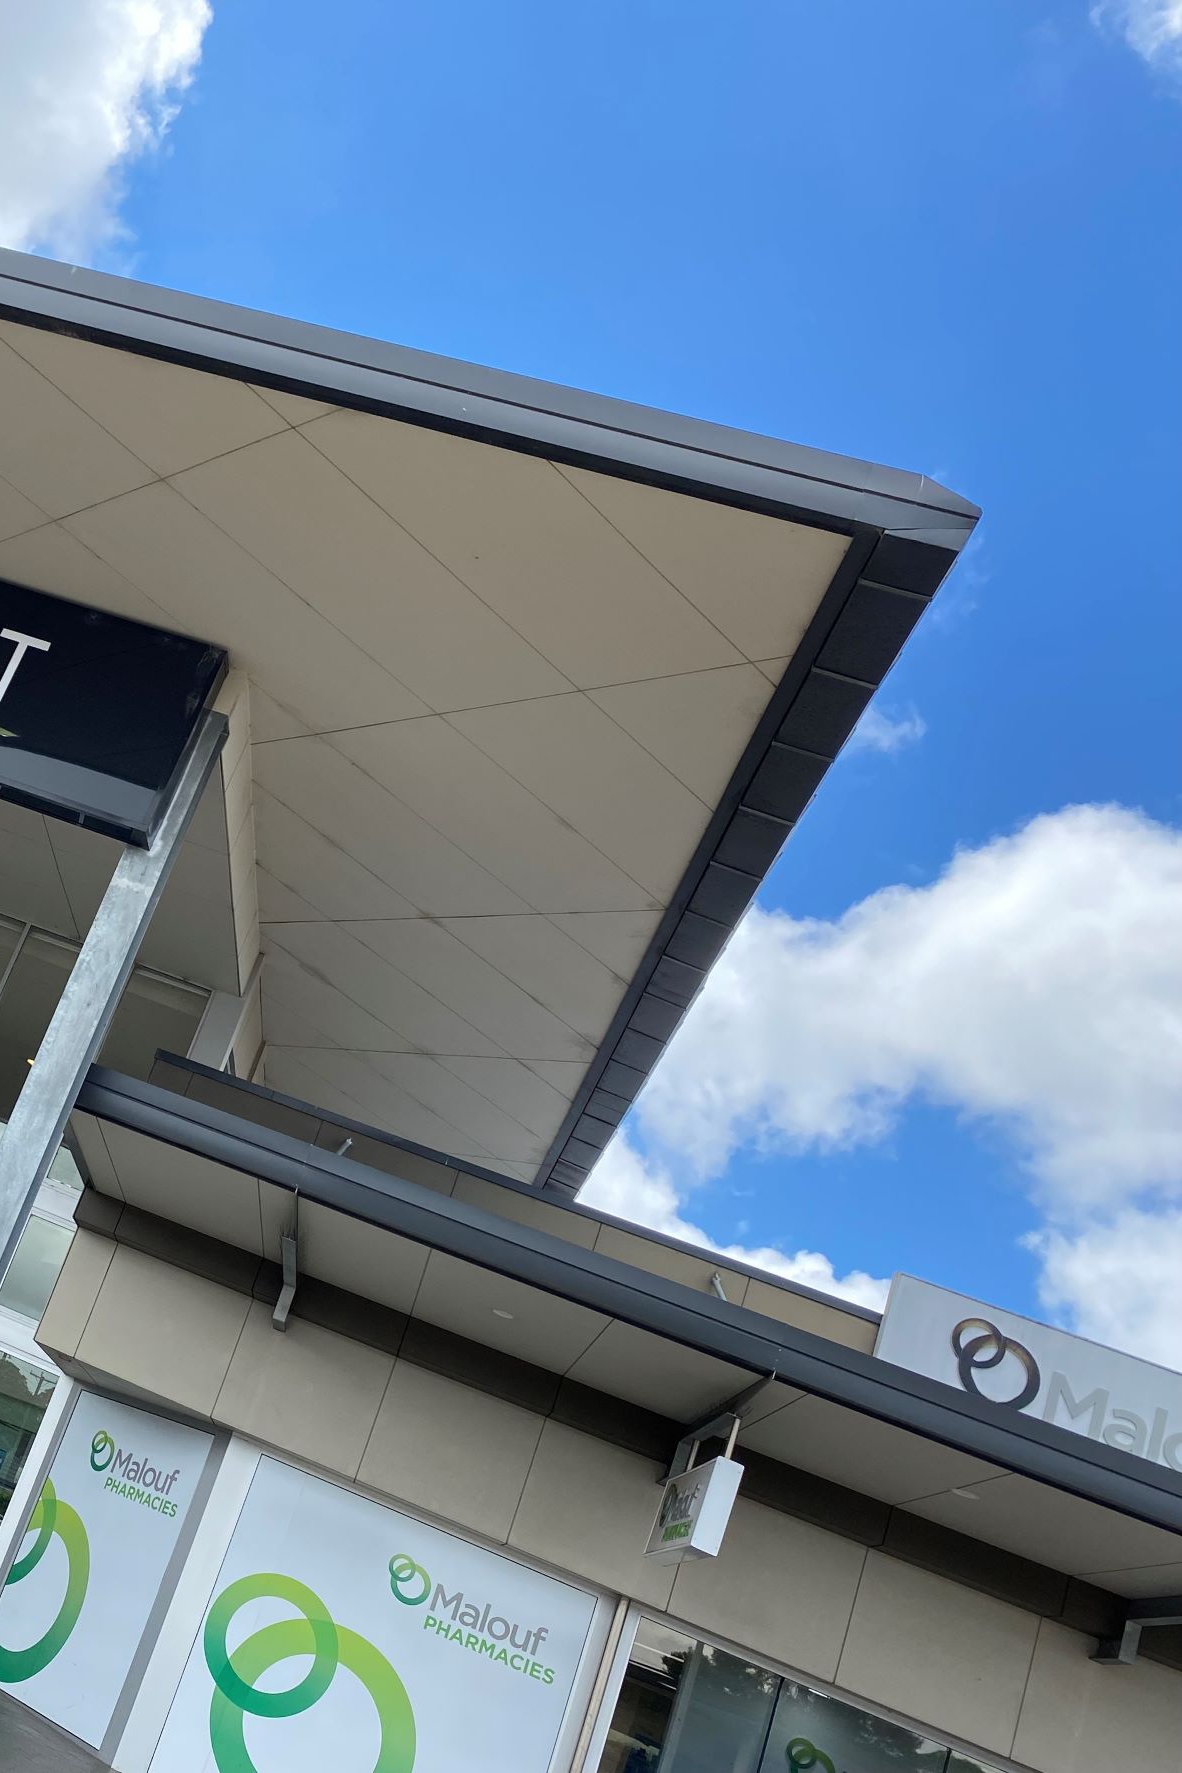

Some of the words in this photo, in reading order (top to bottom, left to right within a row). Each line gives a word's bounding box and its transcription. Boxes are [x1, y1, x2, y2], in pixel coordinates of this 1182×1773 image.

[104, 1477, 178, 1518] PHARMACIES
[110, 1448, 180, 1495] Malouf
[429, 1583, 549, 1656] Malouf
[423, 1615, 556, 1685] PHARMACIES
